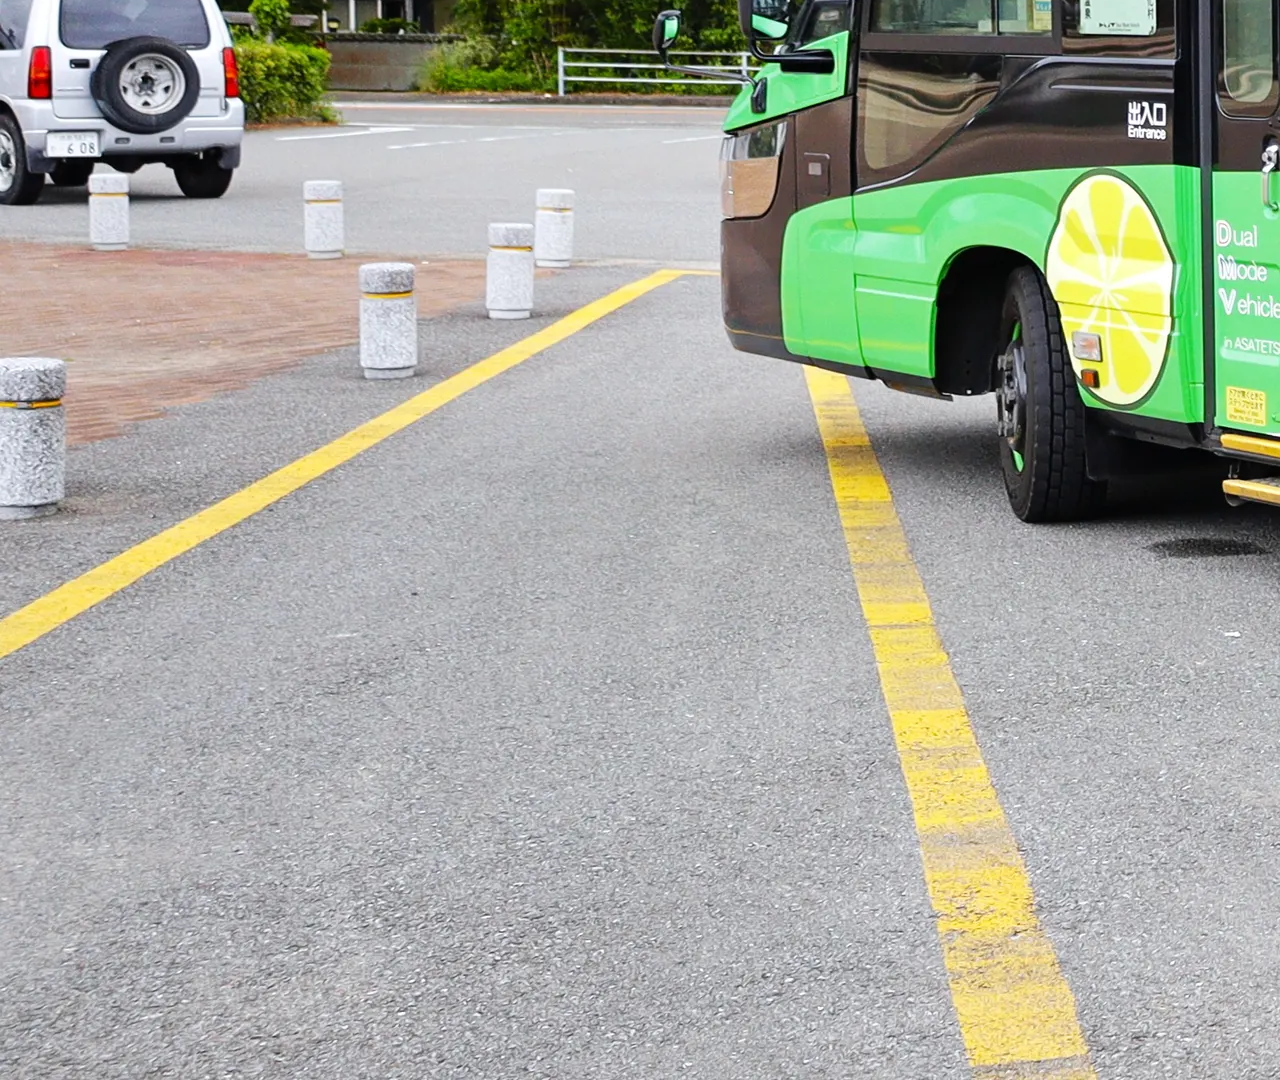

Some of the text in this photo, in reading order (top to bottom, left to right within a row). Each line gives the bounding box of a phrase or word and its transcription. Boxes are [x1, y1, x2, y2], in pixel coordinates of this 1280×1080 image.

[1128, 101, 1167, 126] 出入口
[1128, 125, 1167, 140] Entrance
[1216, 219, 1258, 248] Dual
[1217, 253, 1268, 282] Mode
[1223, 335, 1233, 350] in
